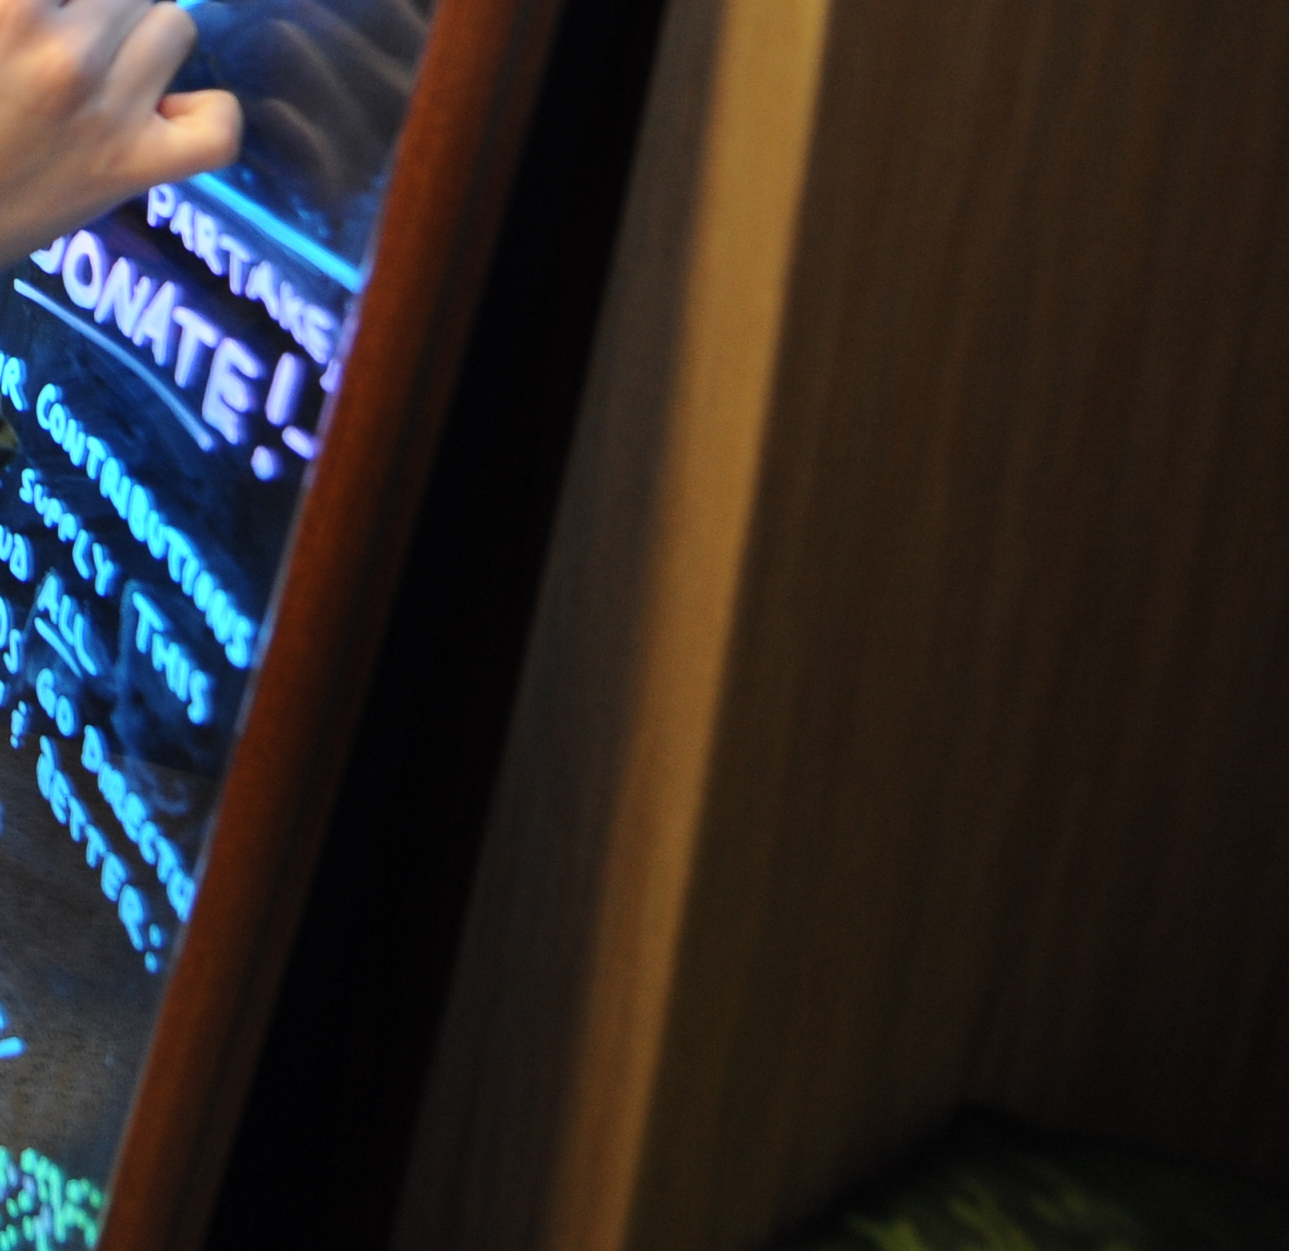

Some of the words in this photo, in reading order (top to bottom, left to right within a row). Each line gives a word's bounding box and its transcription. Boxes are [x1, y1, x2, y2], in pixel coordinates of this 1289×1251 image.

[19, 468, 117, 596] SUPPLY
[132, 591, 213, 725] THIS
[35, 383, 253, 669] CONTRIBUTIONS
[35, 574, 99, 677] ALL
[36, 668, 75, 736] GO
[36, 735, 163, 973] BETTER:
